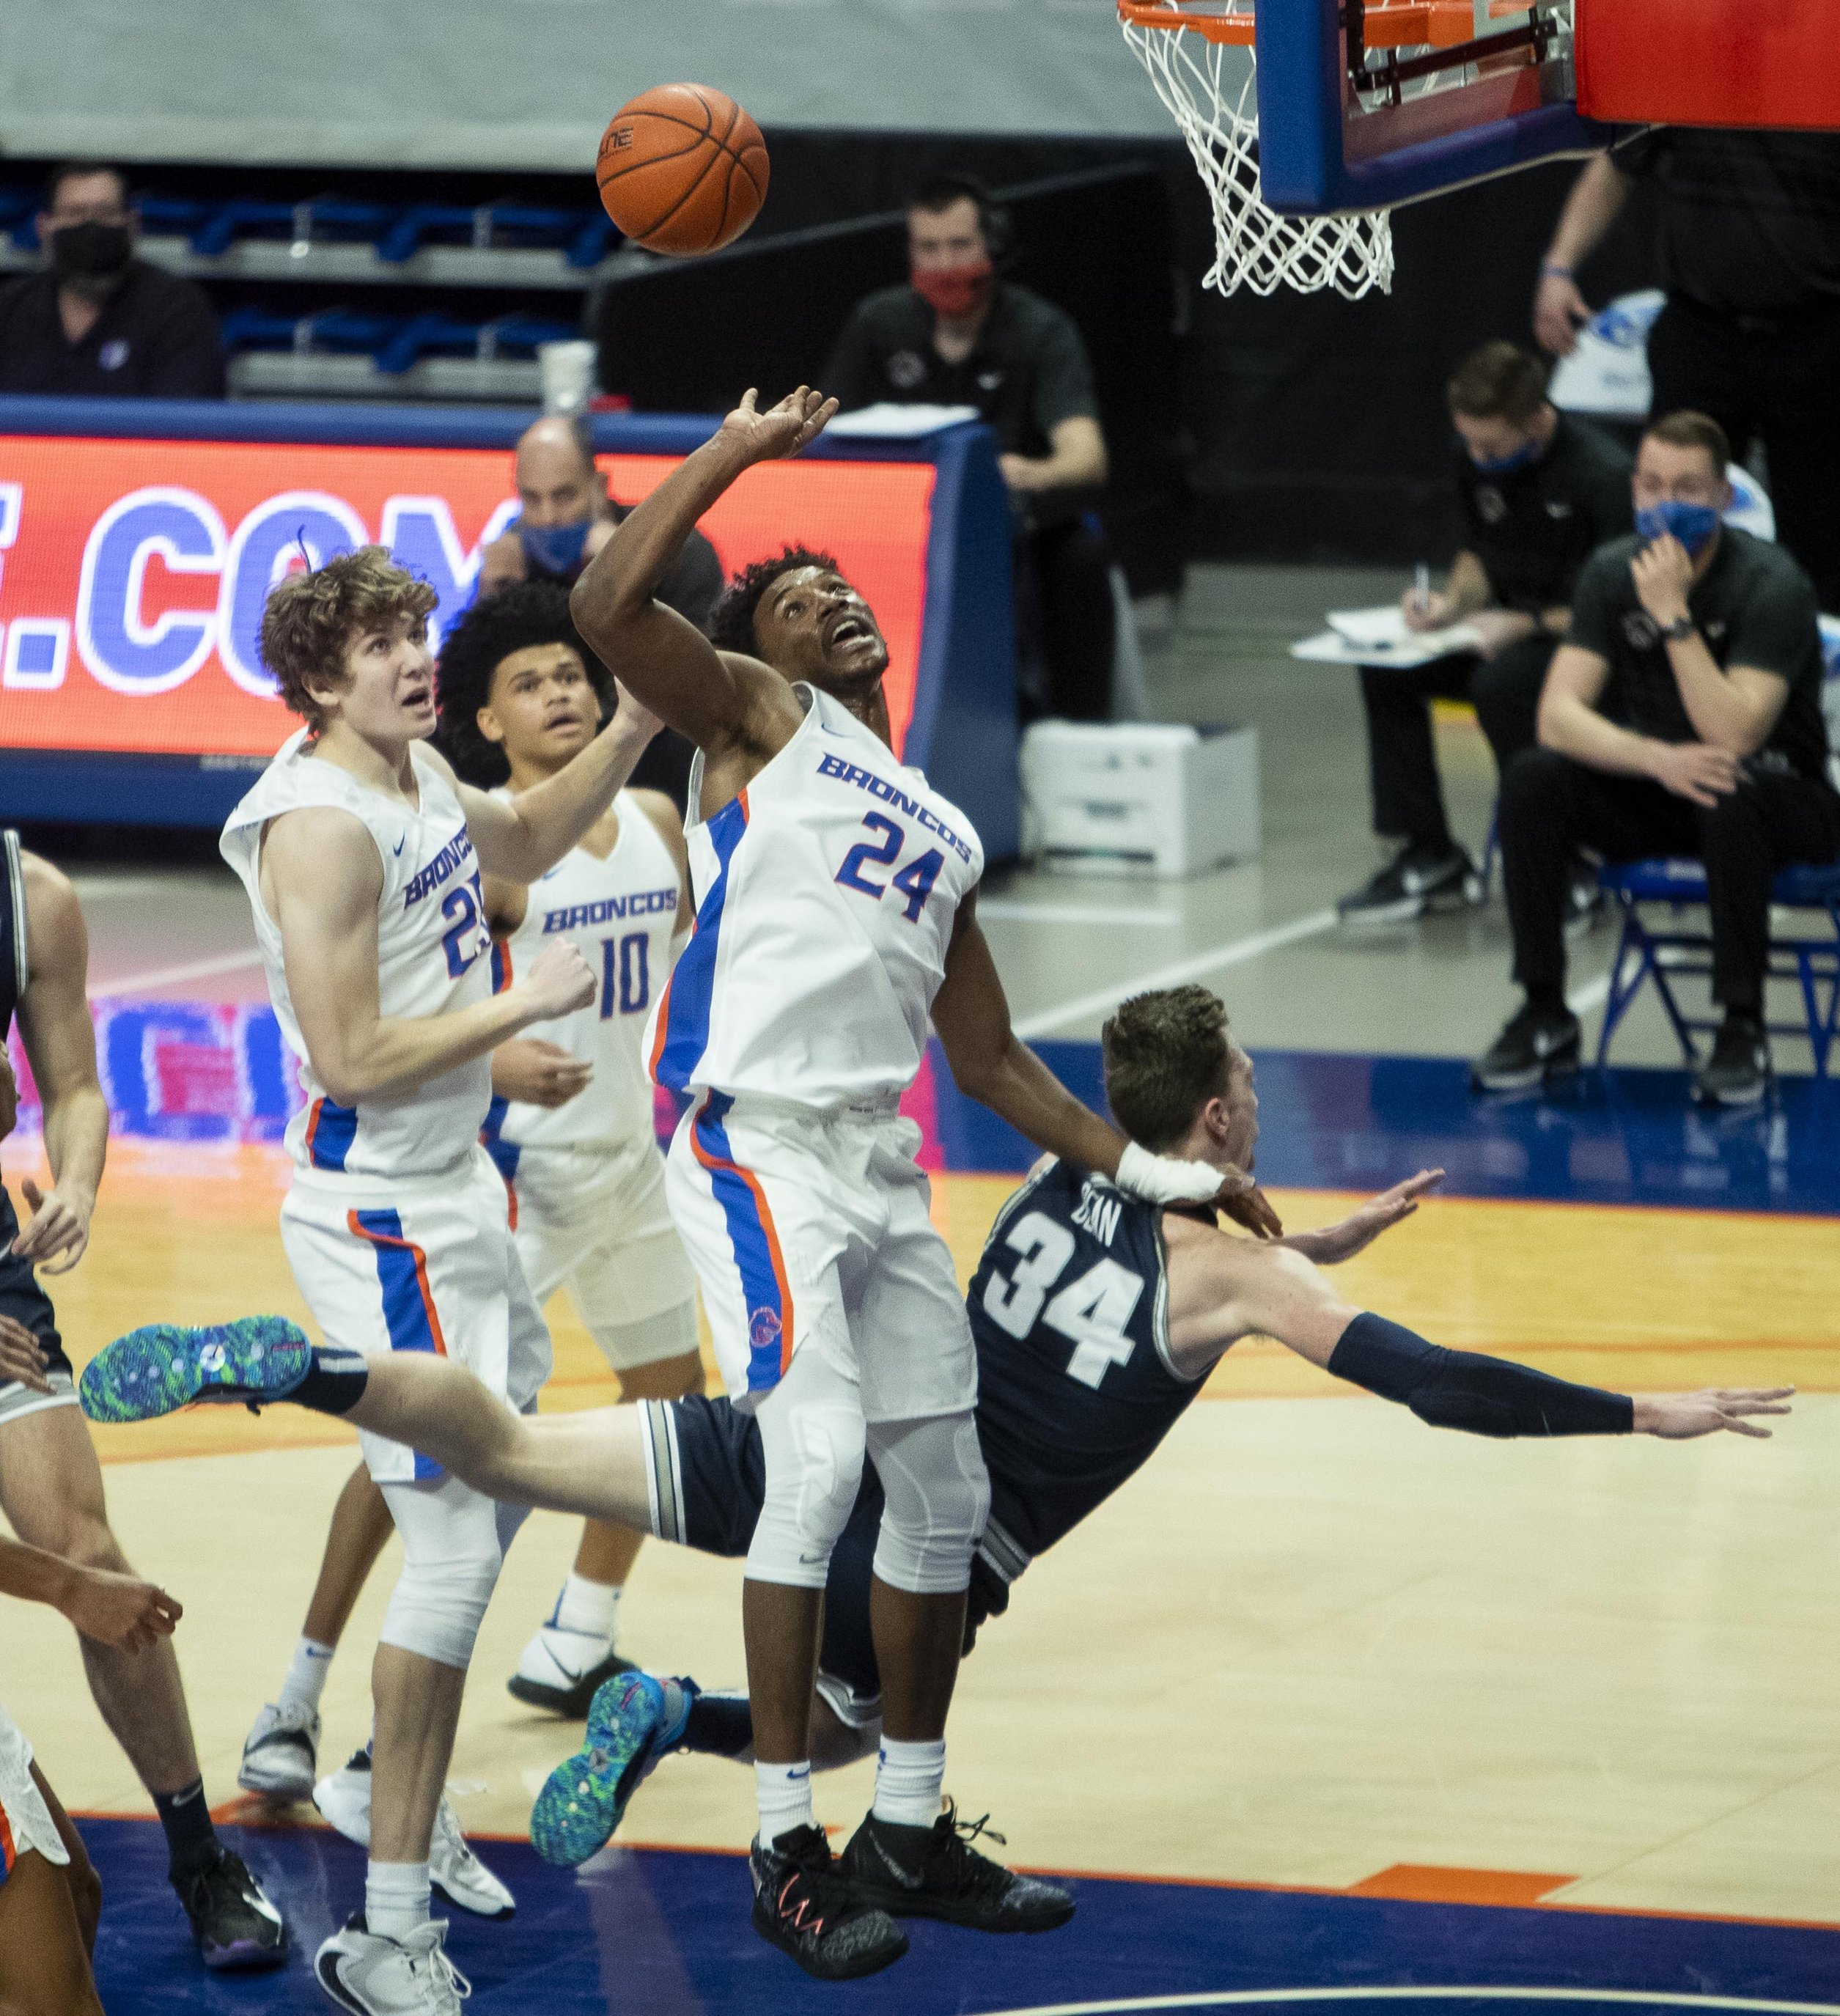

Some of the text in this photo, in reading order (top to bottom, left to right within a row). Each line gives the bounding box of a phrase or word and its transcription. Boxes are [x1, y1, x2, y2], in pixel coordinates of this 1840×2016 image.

[0, 483, 524, 702] .COM
[816, 751, 973, 864] BRONCOS
[542, 888, 677, 935] BRONCOS
[833, 810, 946, 925] 24
[600, 930, 649, 1021] 10
[982, 1210, 1145, 1391] 34
